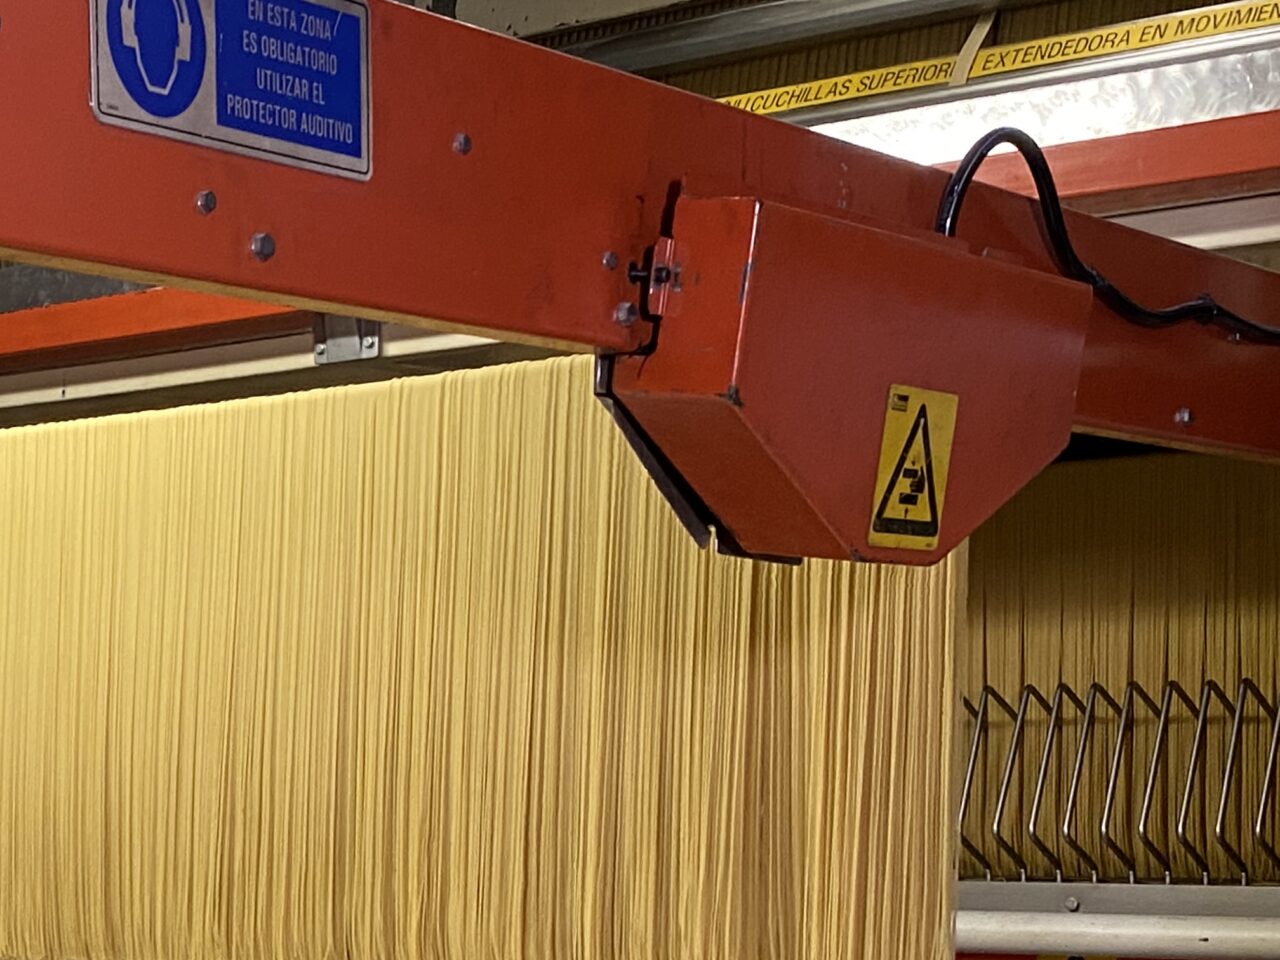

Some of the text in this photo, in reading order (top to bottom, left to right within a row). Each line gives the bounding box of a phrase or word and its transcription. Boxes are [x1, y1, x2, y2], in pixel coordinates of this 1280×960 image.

[248, 0, 331, 41] EN ESTA ZONA
[243, 30, 337, 75] ES OBLIGATORIO
[751, 78, 852, 112] CUCHILLAS
[856, 61, 957, 92] SUPERIOR
[982, 30, 1130, 71] EXTENDEDORA
[1139, 22, 1168, 43] EN
[256, 67, 325, 105] UTILIZAR EL
[227, 94, 353, 144] PROTECTOR AUDITIVO
